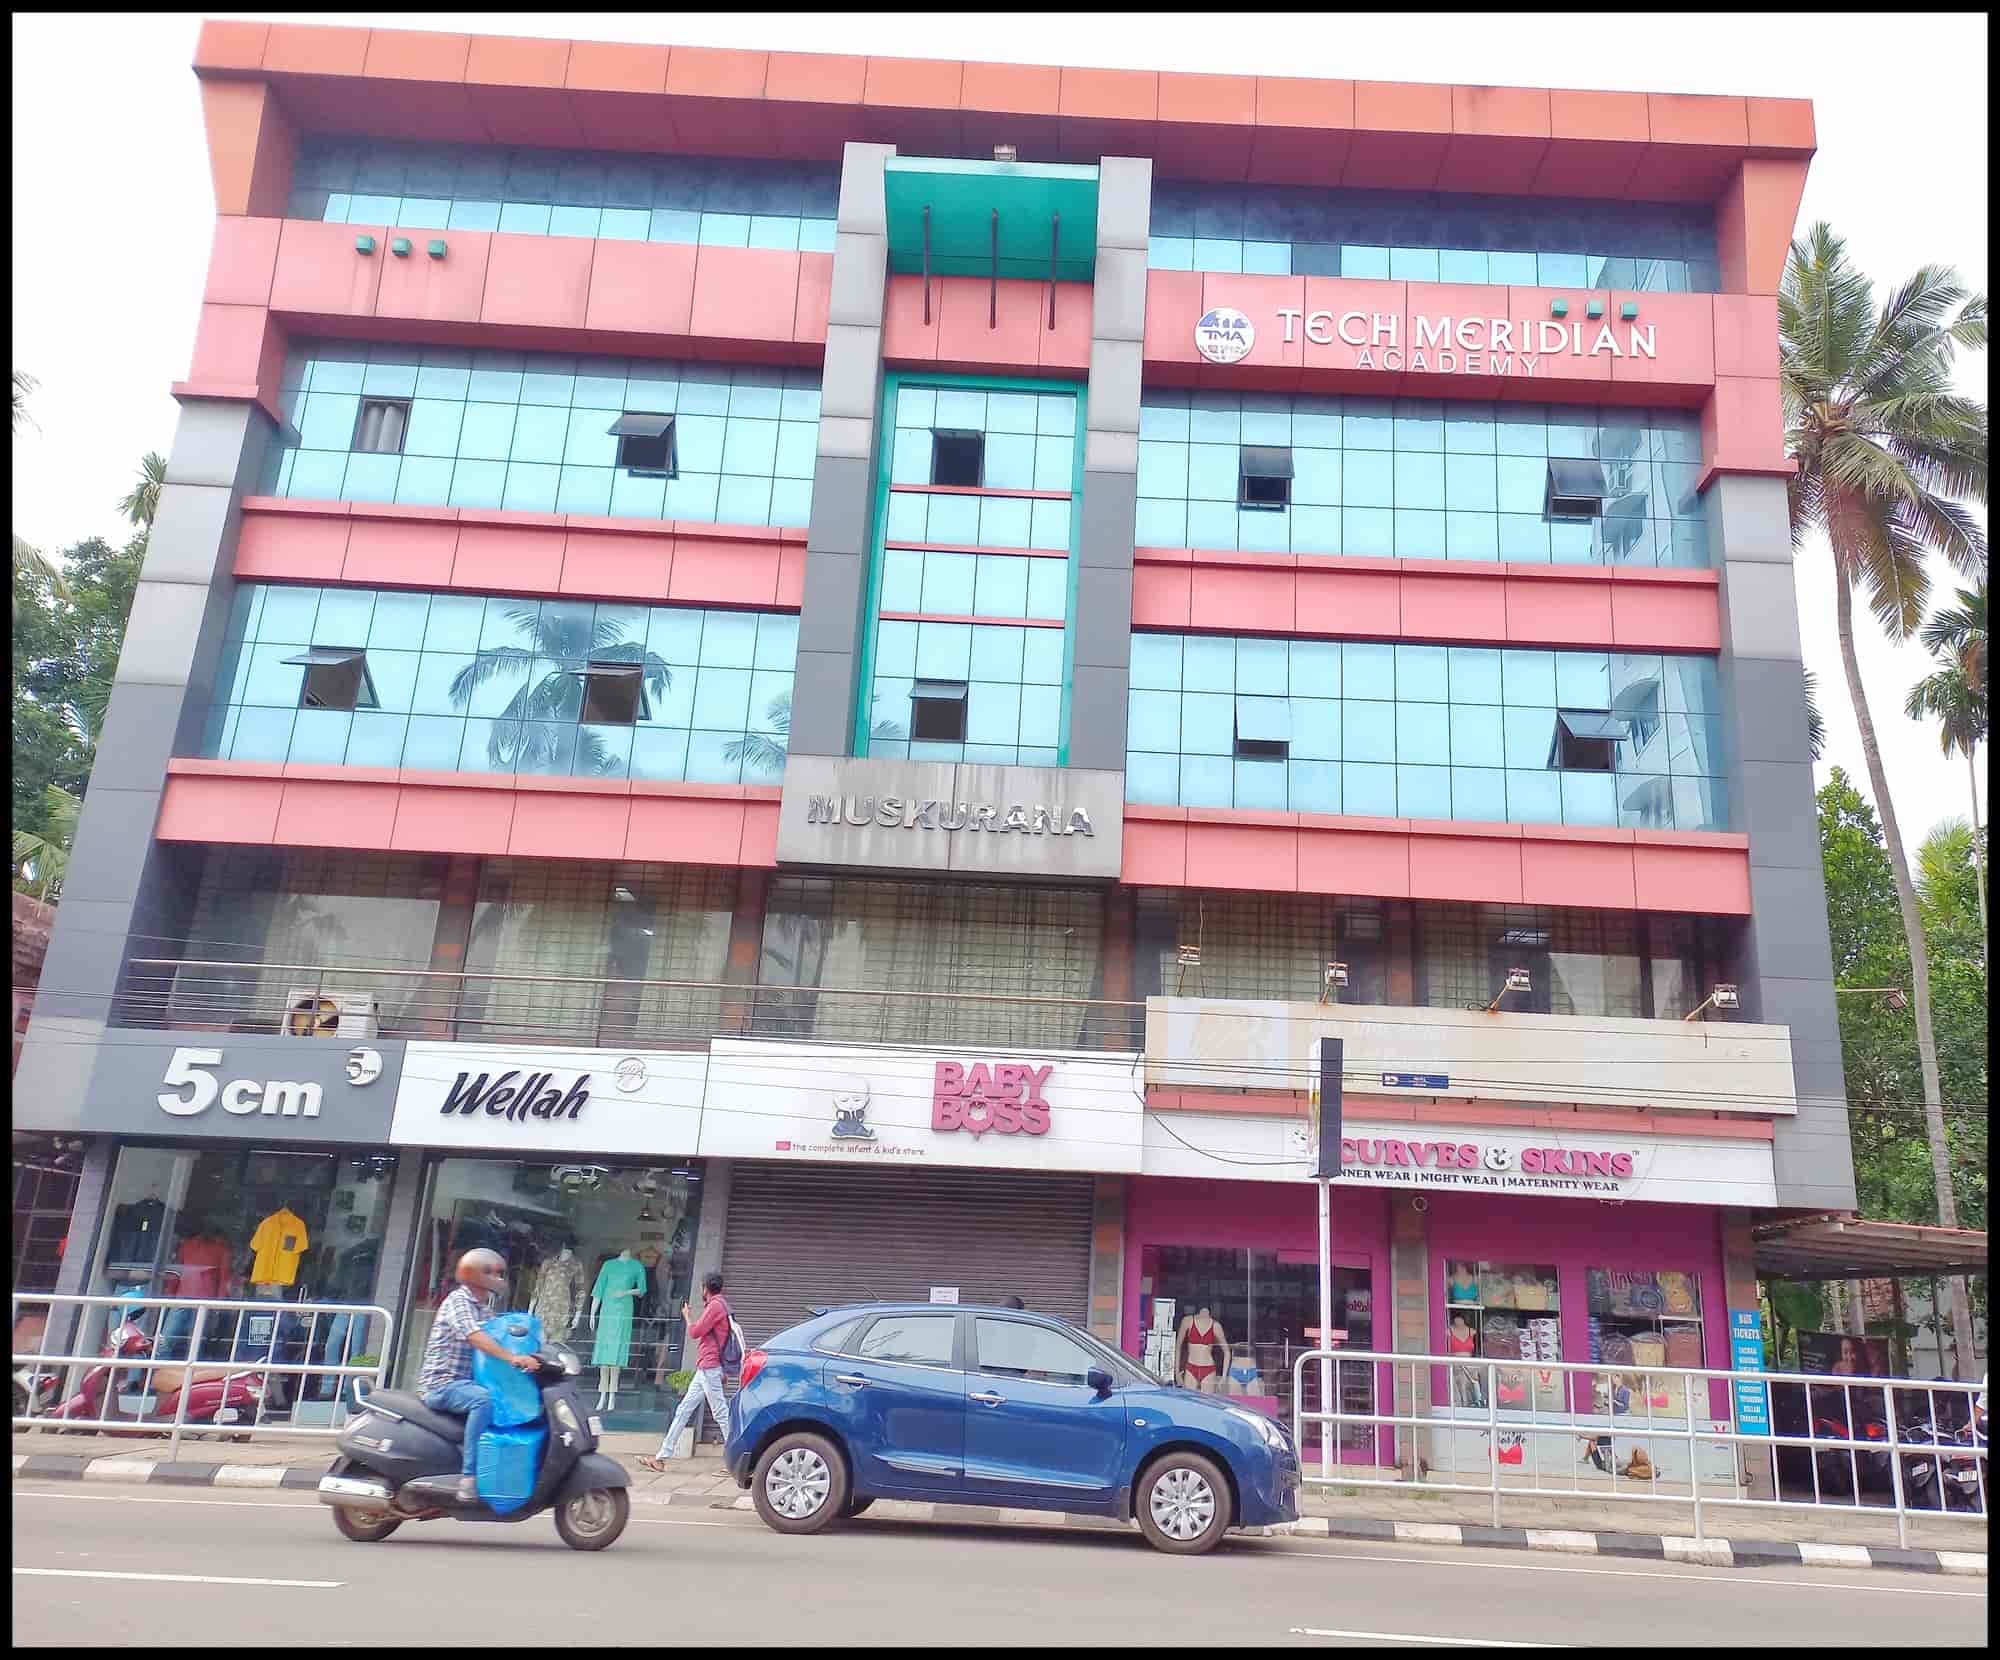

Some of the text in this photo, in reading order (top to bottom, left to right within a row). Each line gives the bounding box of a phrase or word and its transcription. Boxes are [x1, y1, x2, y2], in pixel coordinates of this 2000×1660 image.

[1202, 330, 1246, 346] TMA
[1277, 307, 1657, 358] TECH MERIDIAN
[1356, 349, 1539, 377] ACADEMY
[807, 792, 1095, 837] MUSKURANA
[440, 1070, 591, 1122] Wellah
[933, 1061, 1053, 1098] BABY
[931, 1097, 1051, 1136] BOSS
[792, 1143, 807, 1153] the
[808, 1144, 845, 1155] complete
[847, 1144, 872, 1155] infant
[1340, 1137, 1479, 1169] CURVES
[1484, 1144, 1512, 1171] &
[1521, 1147, 1634, 1178] SKINS
[1340, 1168, 1619, 1191] NNER WEAR NIGHT WEAR MATERNITY WEAR
